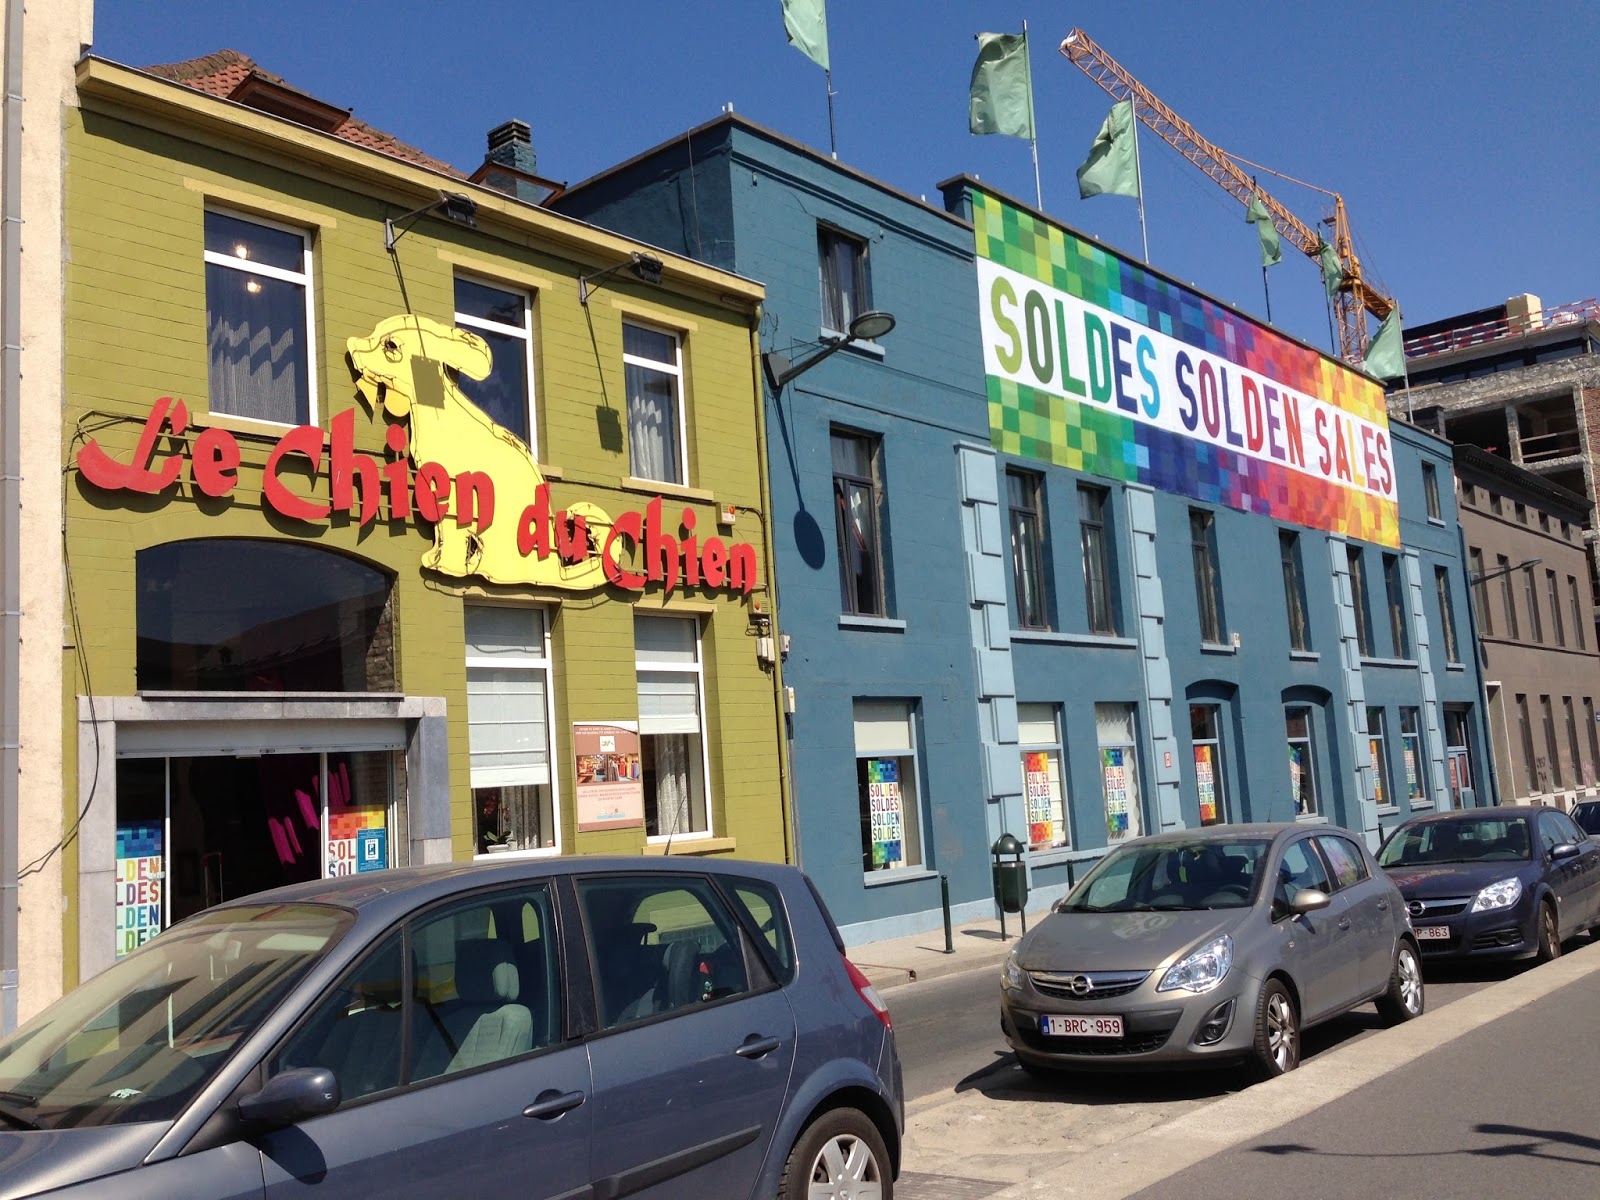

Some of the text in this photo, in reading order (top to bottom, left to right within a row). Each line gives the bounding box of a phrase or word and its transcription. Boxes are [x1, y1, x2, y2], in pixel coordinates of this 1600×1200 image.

[991, 276, 1392, 495] SOLDES SOLDEN SALES
[77, 397, 756, 595] Le Chien du Chien
[870, 783, 898, 797] SOLDEN
[1029, 785, 1050, 797] SOLDES
[871, 798, 899, 812] SOLDES
[872, 812, 900, 827] SOLDEN
[873, 826, 901, 841] SOLDES
